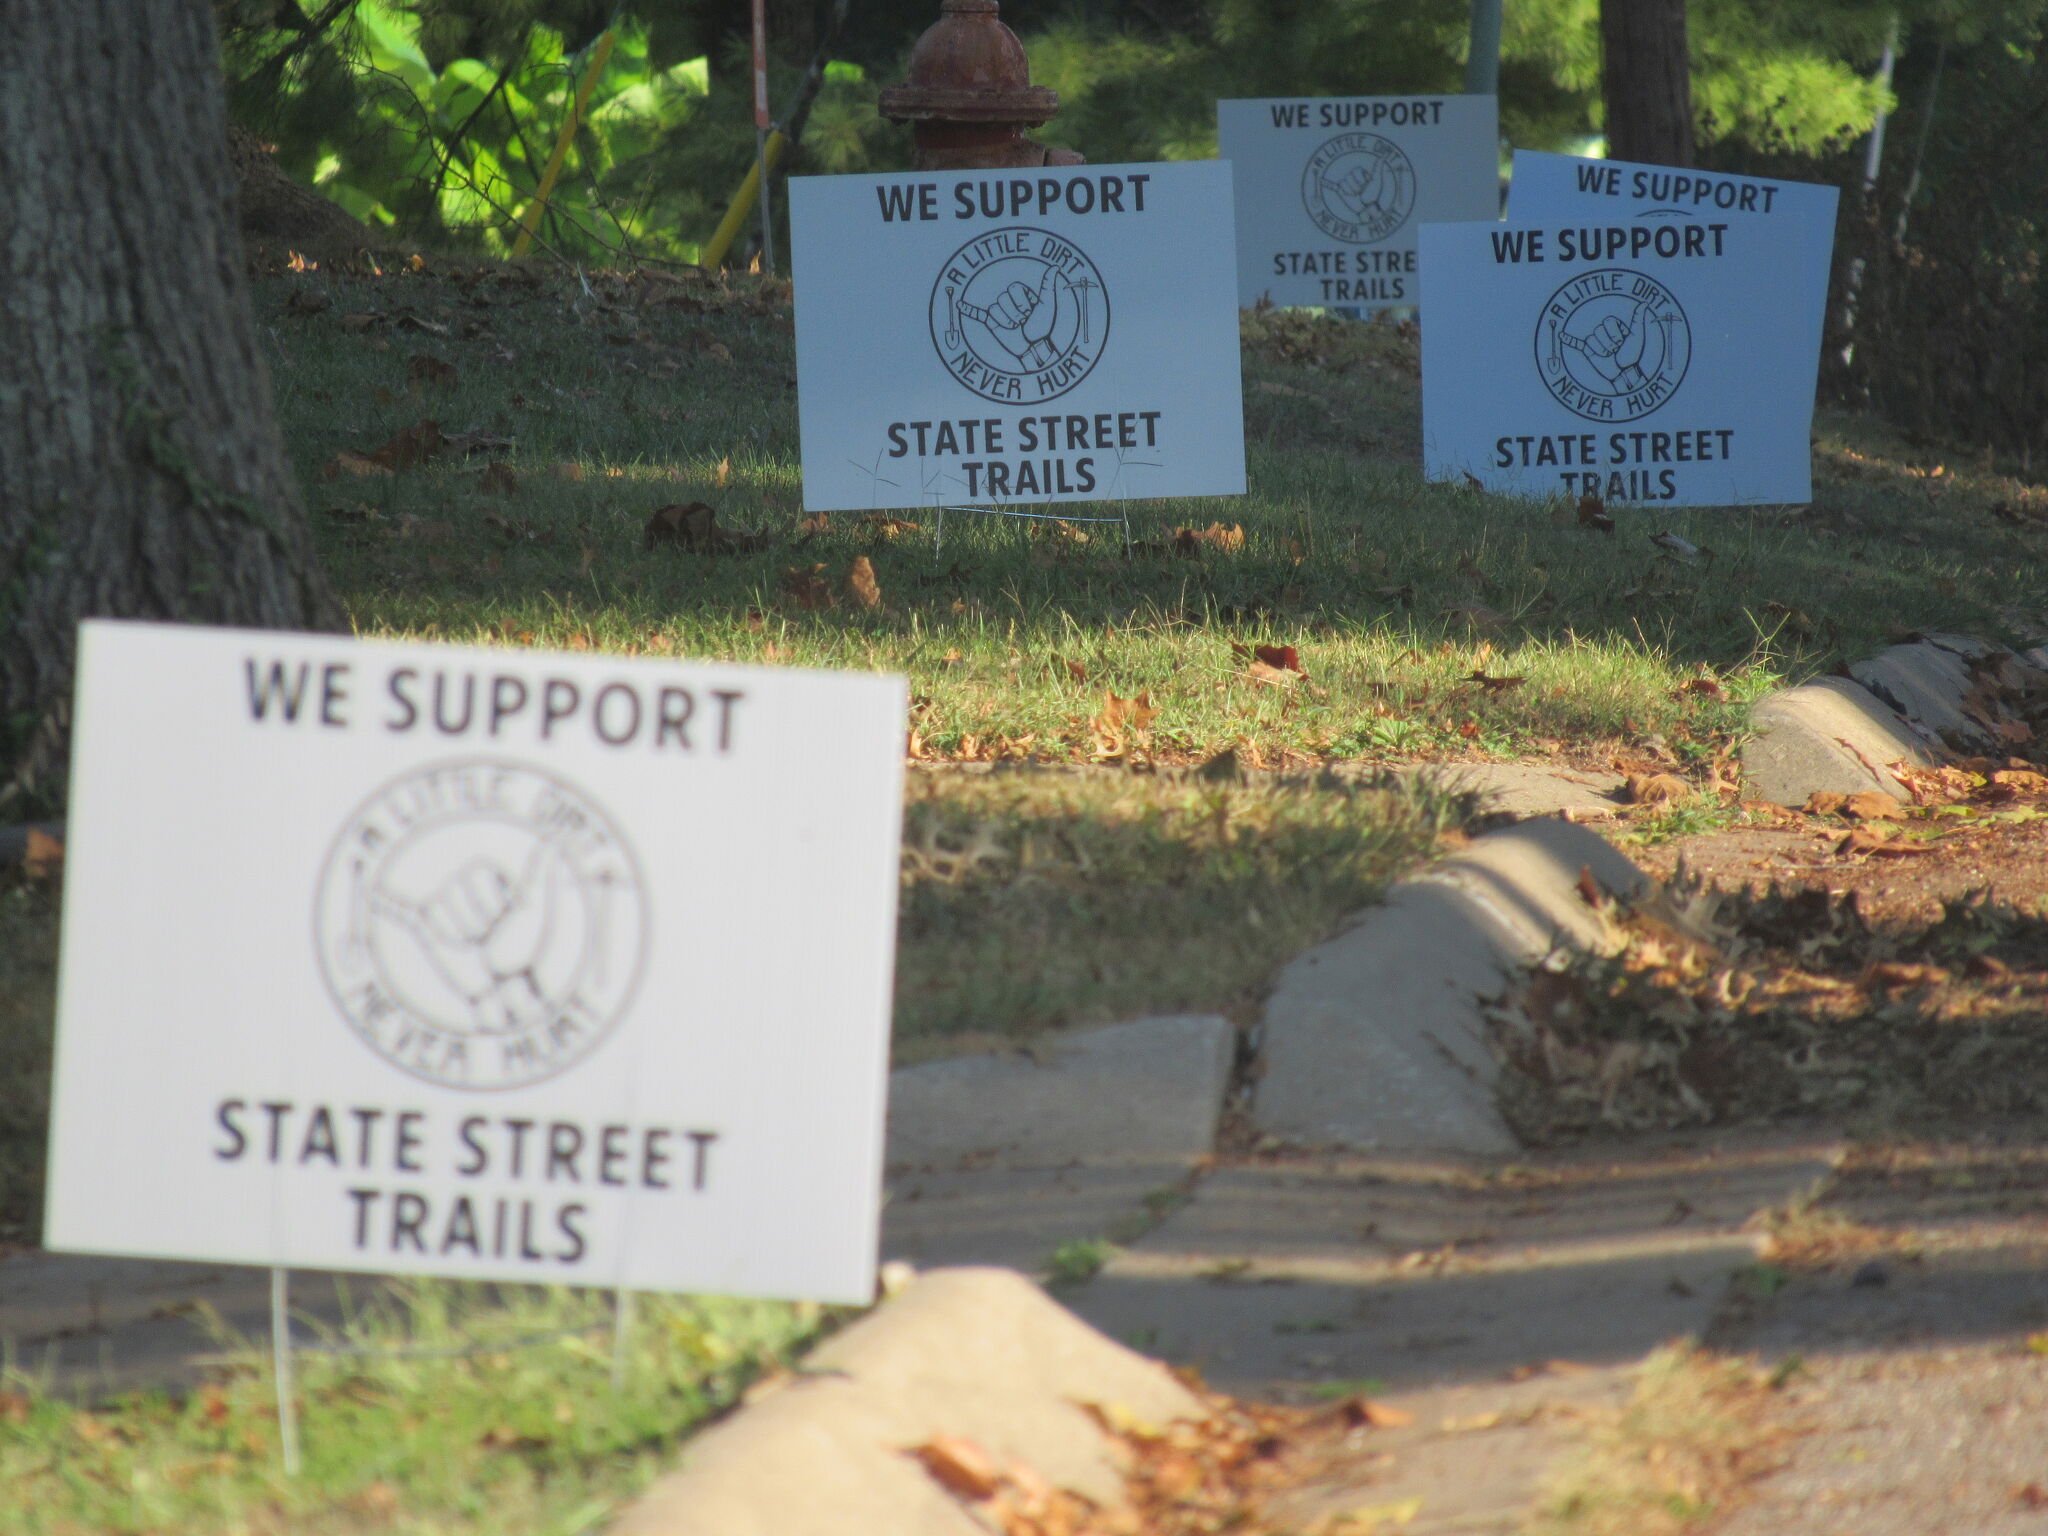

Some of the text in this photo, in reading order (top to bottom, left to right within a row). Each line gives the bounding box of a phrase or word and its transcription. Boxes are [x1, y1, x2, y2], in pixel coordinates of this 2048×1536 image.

[1272, 102, 1443, 128] WE SUPPORT
[877, 174, 1150, 221] WE SUPPORT
[1578, 165, 1778, 213] WE SUPPORT
[947, 233, 1084, 287] A LITTLE DIRT
[1274, 251, 1416, 275] STATE STRE
[1492, 224, 1728, 263] WE SUPPORT
[1320, 278, 1404, 300] TRAILS
[1553, 274, 1670, 319] A LITTLE DIRT
[951, 345, 1090, 399] NEVER HURT
[1552, 375, 1673, 418] NEVER HURT
[887, 412, 1161, 458] STATE STREET
[1496, 430, 1734, 467] STATE STREET
[962, 458, 1096, 497] TRAILS
[1560, 469, 1676, 500] TRAILS
[243, 658, 746, 753] WE SUPPORT
[213, 1098, 719, 1192] STATE STREET
[346, 1189, 590, 1265] TRAILS
